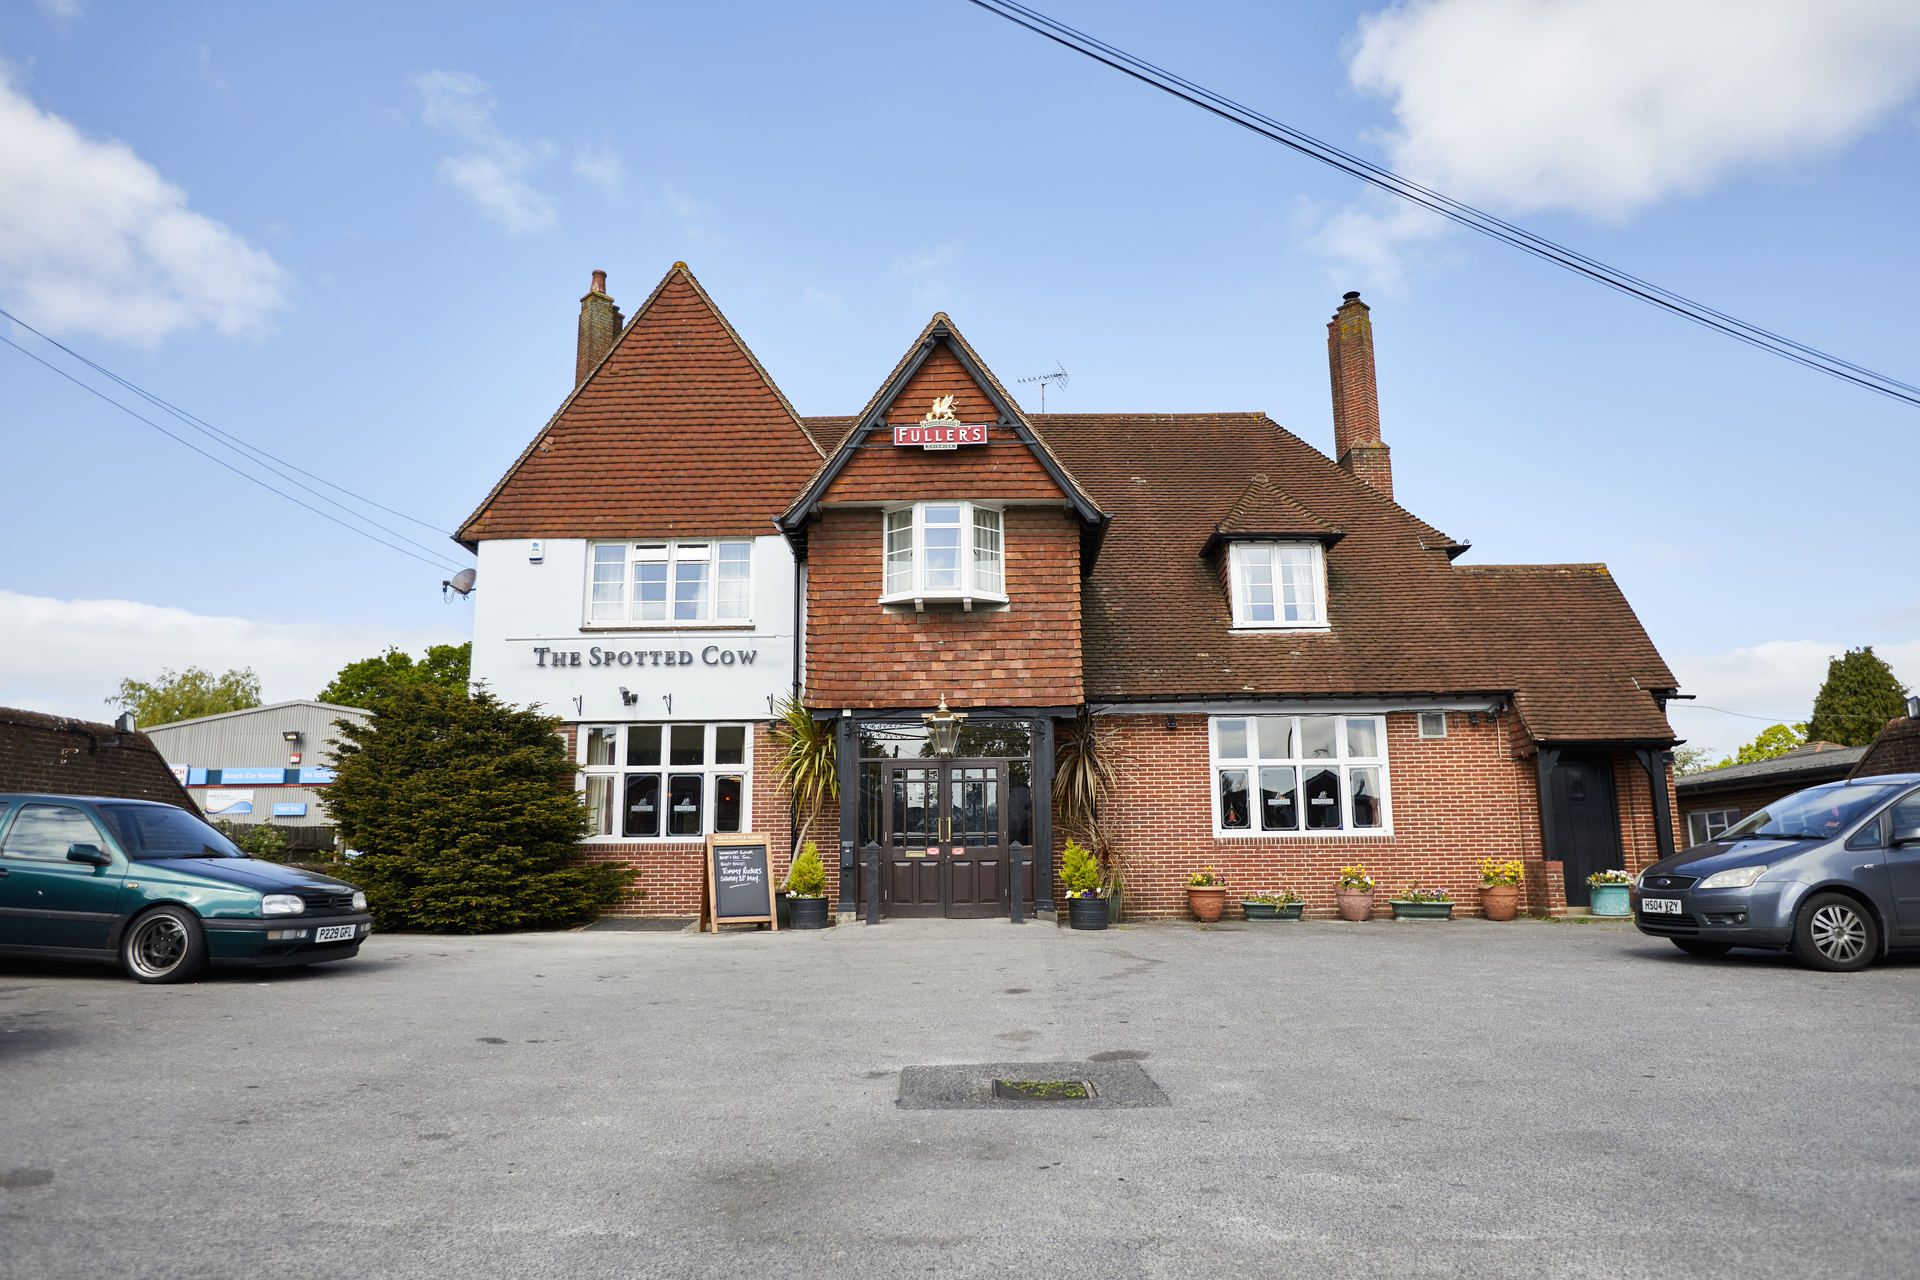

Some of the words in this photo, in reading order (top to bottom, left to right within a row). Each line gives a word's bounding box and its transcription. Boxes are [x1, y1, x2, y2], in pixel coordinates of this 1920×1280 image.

[898, 425, 981, 442] FULLER'S
[533, 647, 581, 667] THE
[589, 646, 693, 667] SPOTTED
[701, 645, 758, 666] COW
[245, 772, 256, 780] Car
[721, 867, 741, 875] TOMMY
[1644, 899, 1663, 911] HS04
[319, 927, 340, 940] P229
[340, 926, 352, 938] GFL
